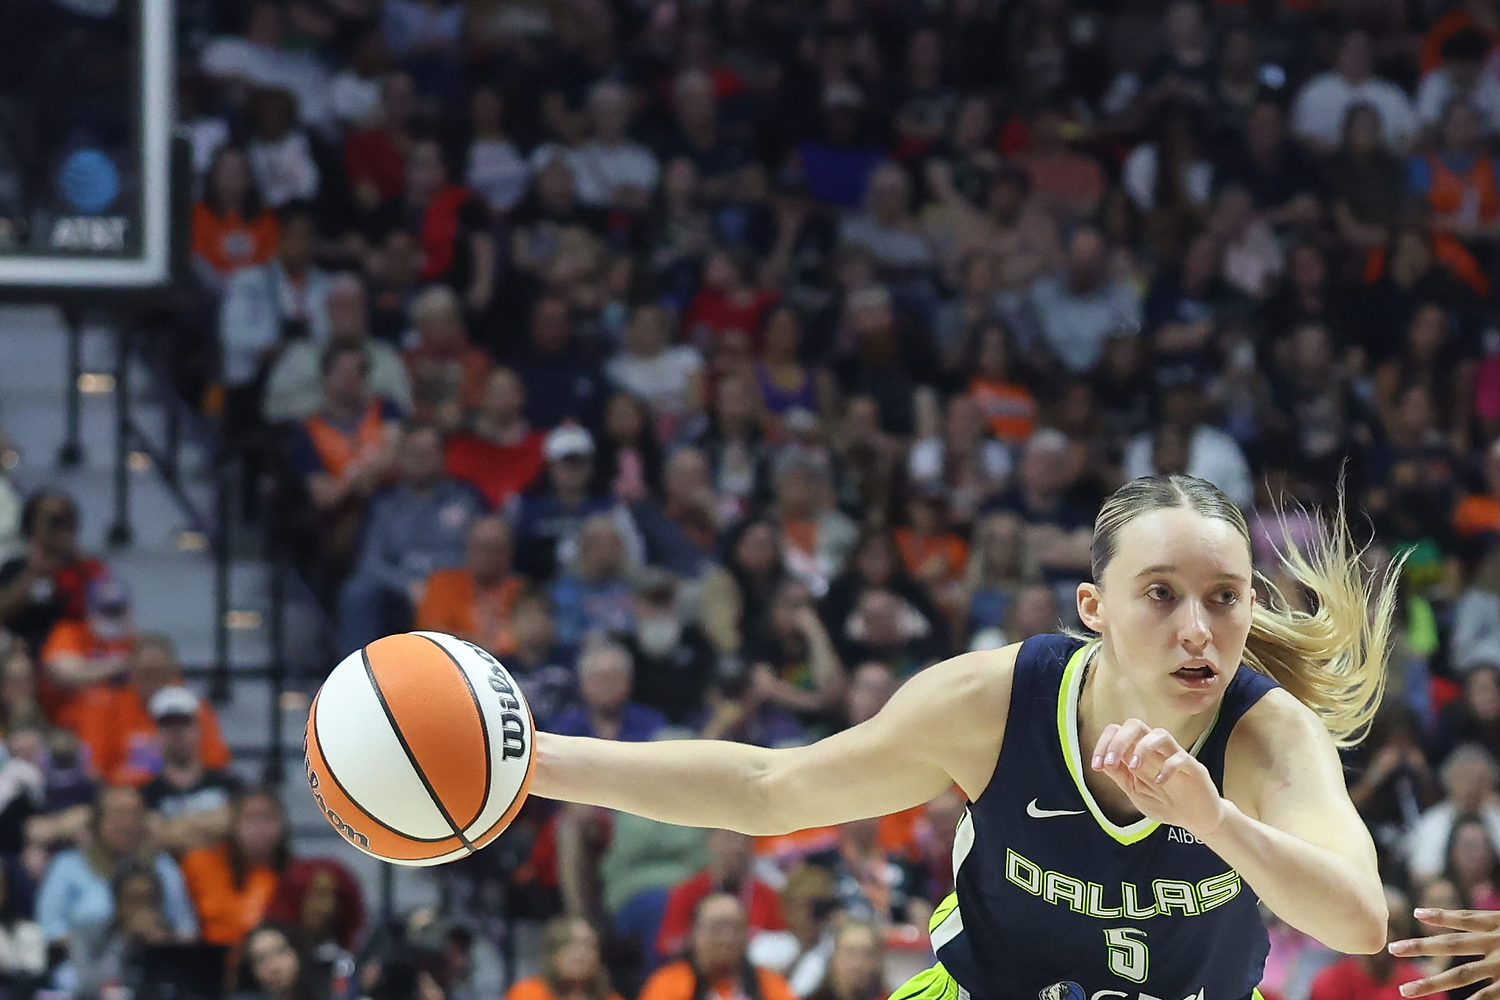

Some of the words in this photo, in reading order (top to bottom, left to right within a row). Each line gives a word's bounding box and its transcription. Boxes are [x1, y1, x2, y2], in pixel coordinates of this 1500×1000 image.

[303, 722, 371, 850] ilson
[1005, 847, 1242, 920] DALLAS
[1102, 926, 1149, 984] 5
